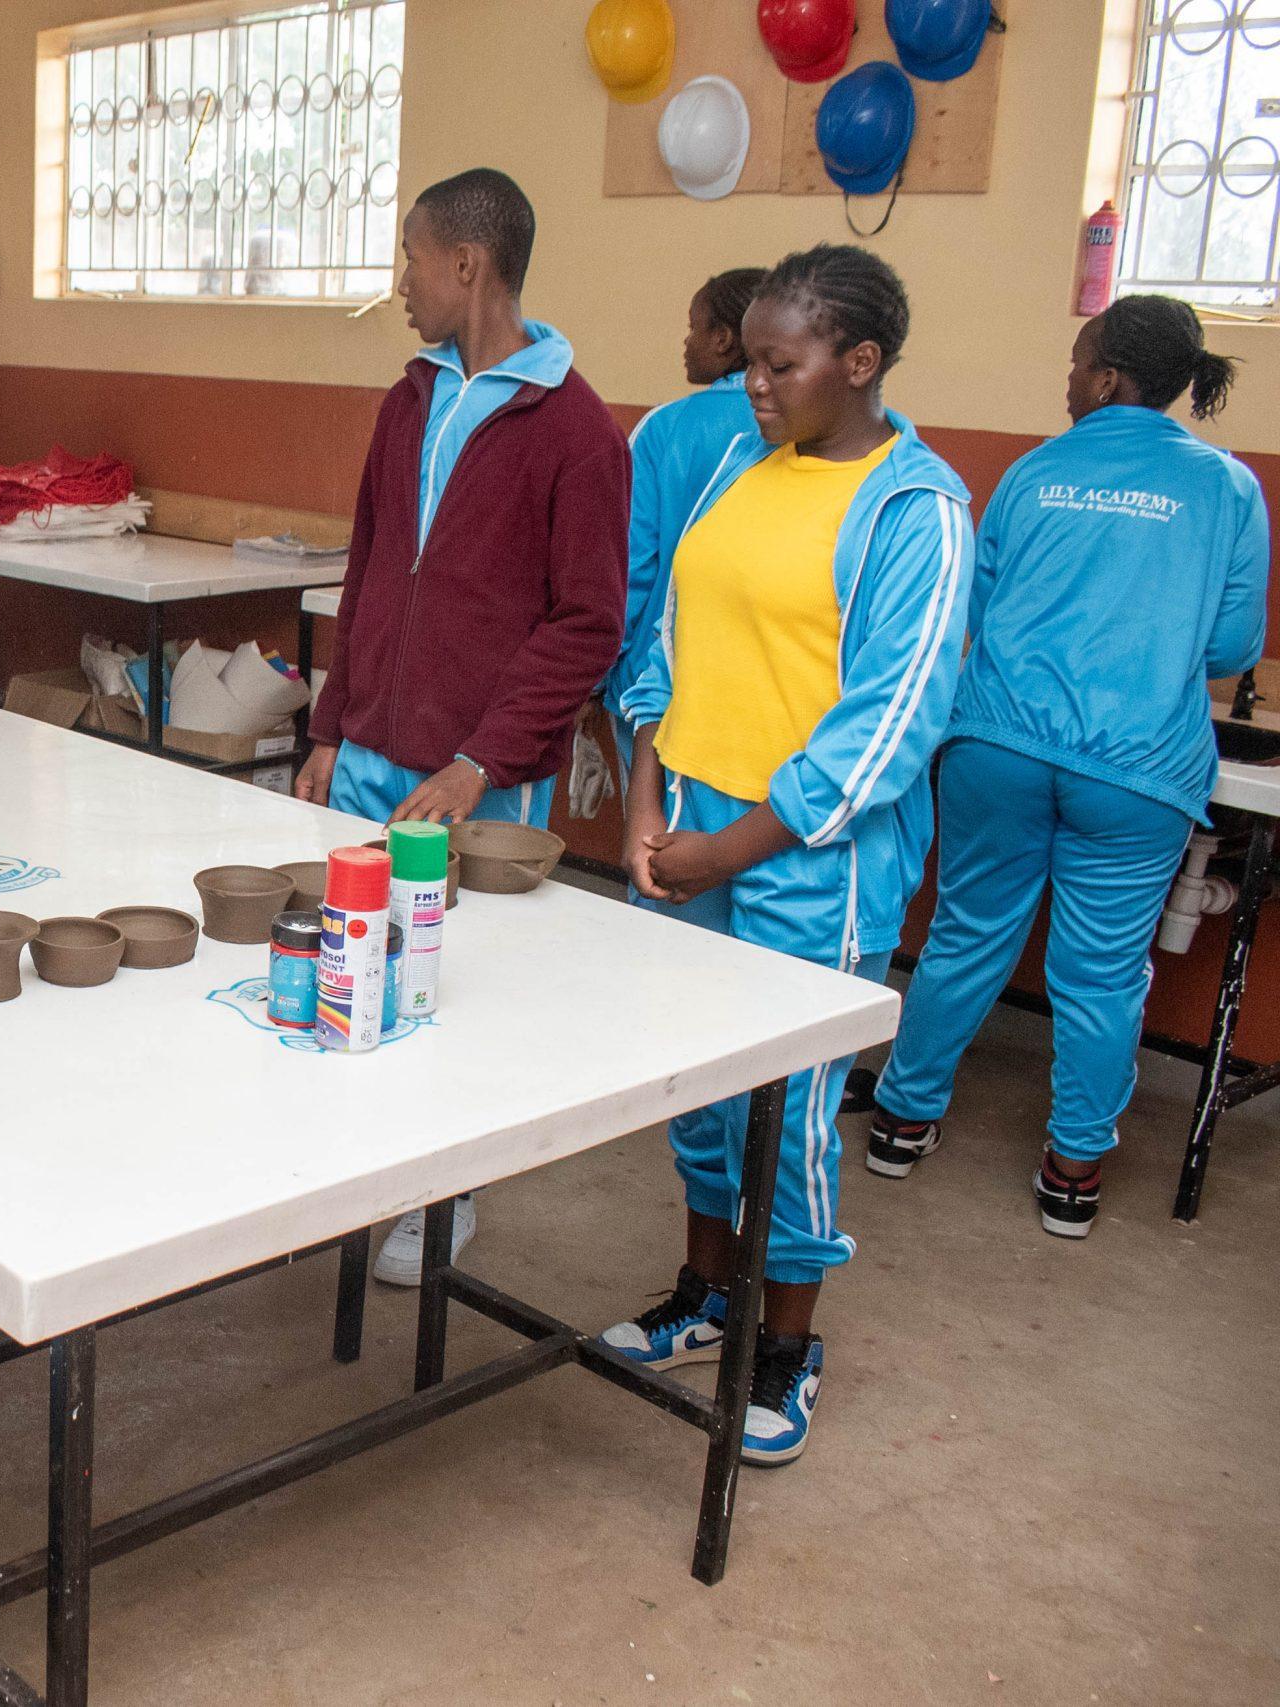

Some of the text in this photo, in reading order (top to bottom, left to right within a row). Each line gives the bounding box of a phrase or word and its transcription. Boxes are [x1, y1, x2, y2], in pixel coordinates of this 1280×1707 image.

[1038, 485, 1184, 515] LILY ACADEMY
[1040, 500, 1170, 522] Mixed Day & Boarding School
[414, 891, 440, 902] FMS
